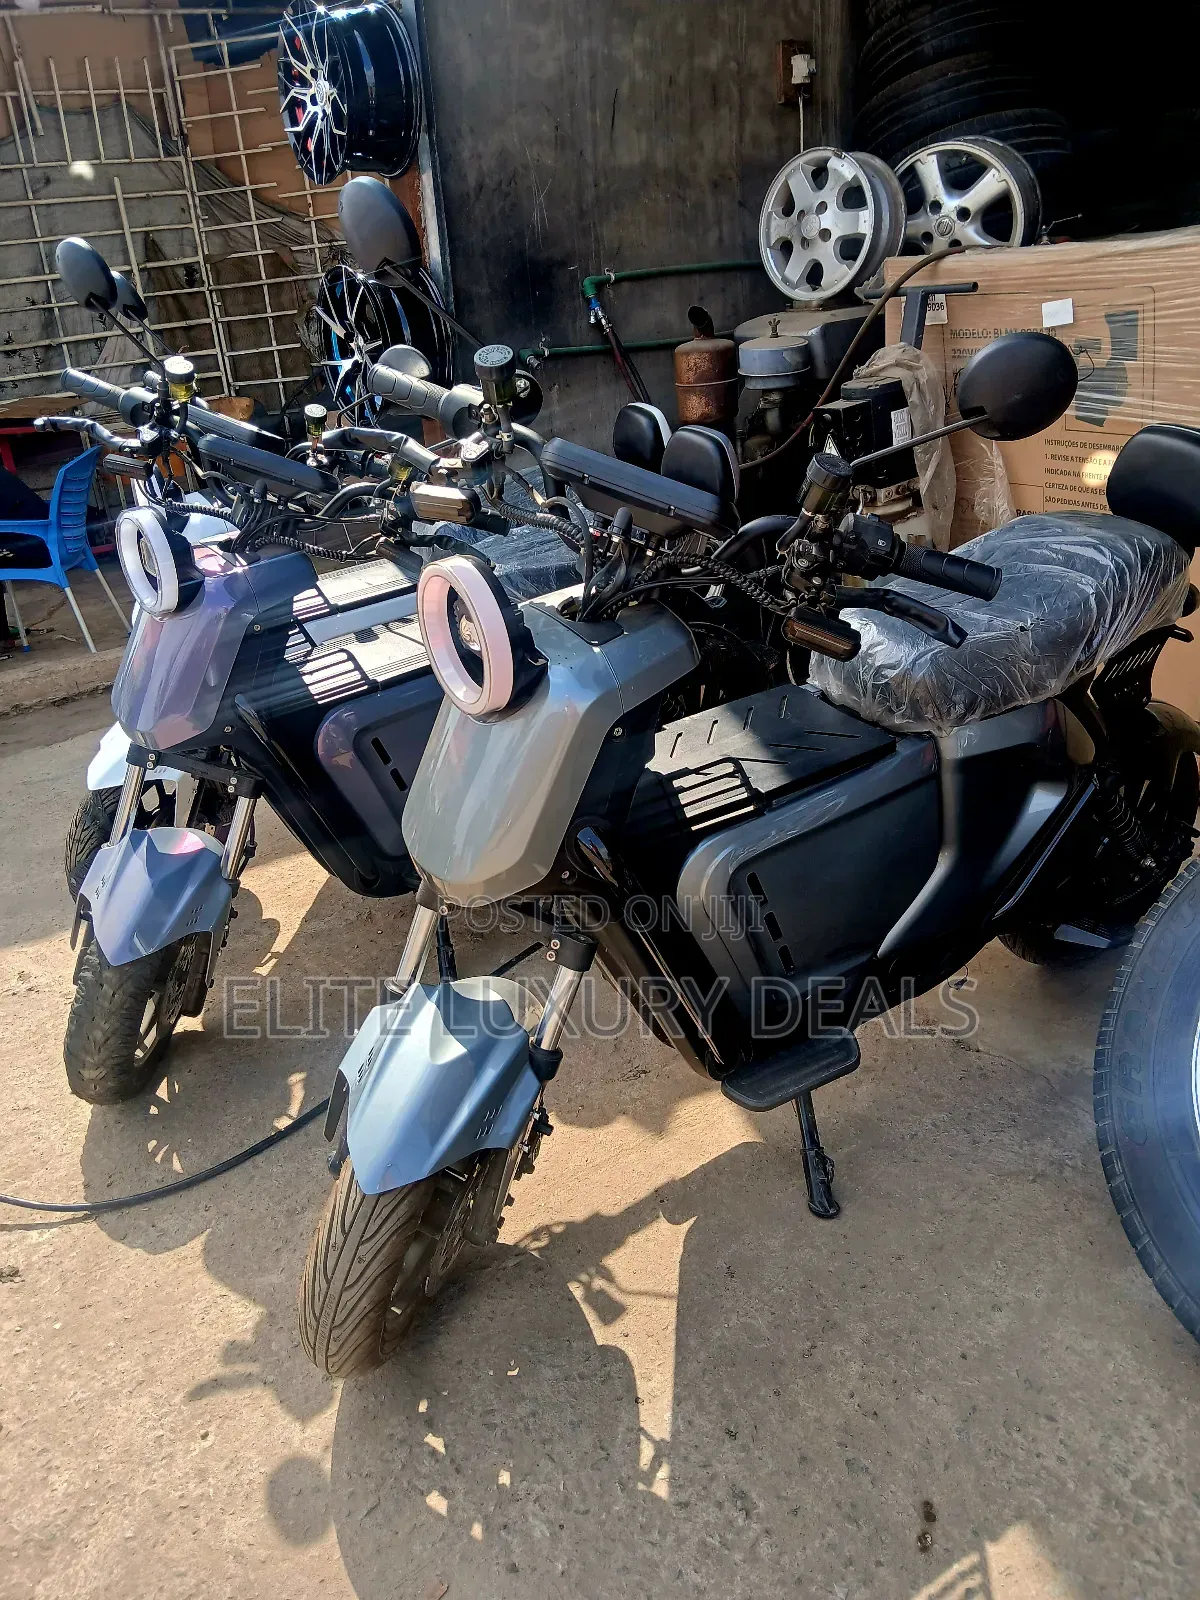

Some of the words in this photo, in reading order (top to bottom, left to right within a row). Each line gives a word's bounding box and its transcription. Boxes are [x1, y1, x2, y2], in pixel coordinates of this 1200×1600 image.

[950, 328, 992, 339] MODELO:
[1044, 438, 1079, 448] INSTRUÇÕES
[1050, 453, 1070, 462] REVISE
[1044, 467, 1072, 477] INDICADA
[1072, 470, 1081, 478] NA
[1081, 471, 1103, 480] FRENTE
[1044, 481, 1069, 491] CERTEZA
[1069, 484, 1077, 492] DE
[1077, 486, 1090, 494] QUE
[1090, 487, 1098, 495] AS
[1056, 497, 1081, 507] PEDIDAS
[1080, 500, 1099, 510] ANTES
